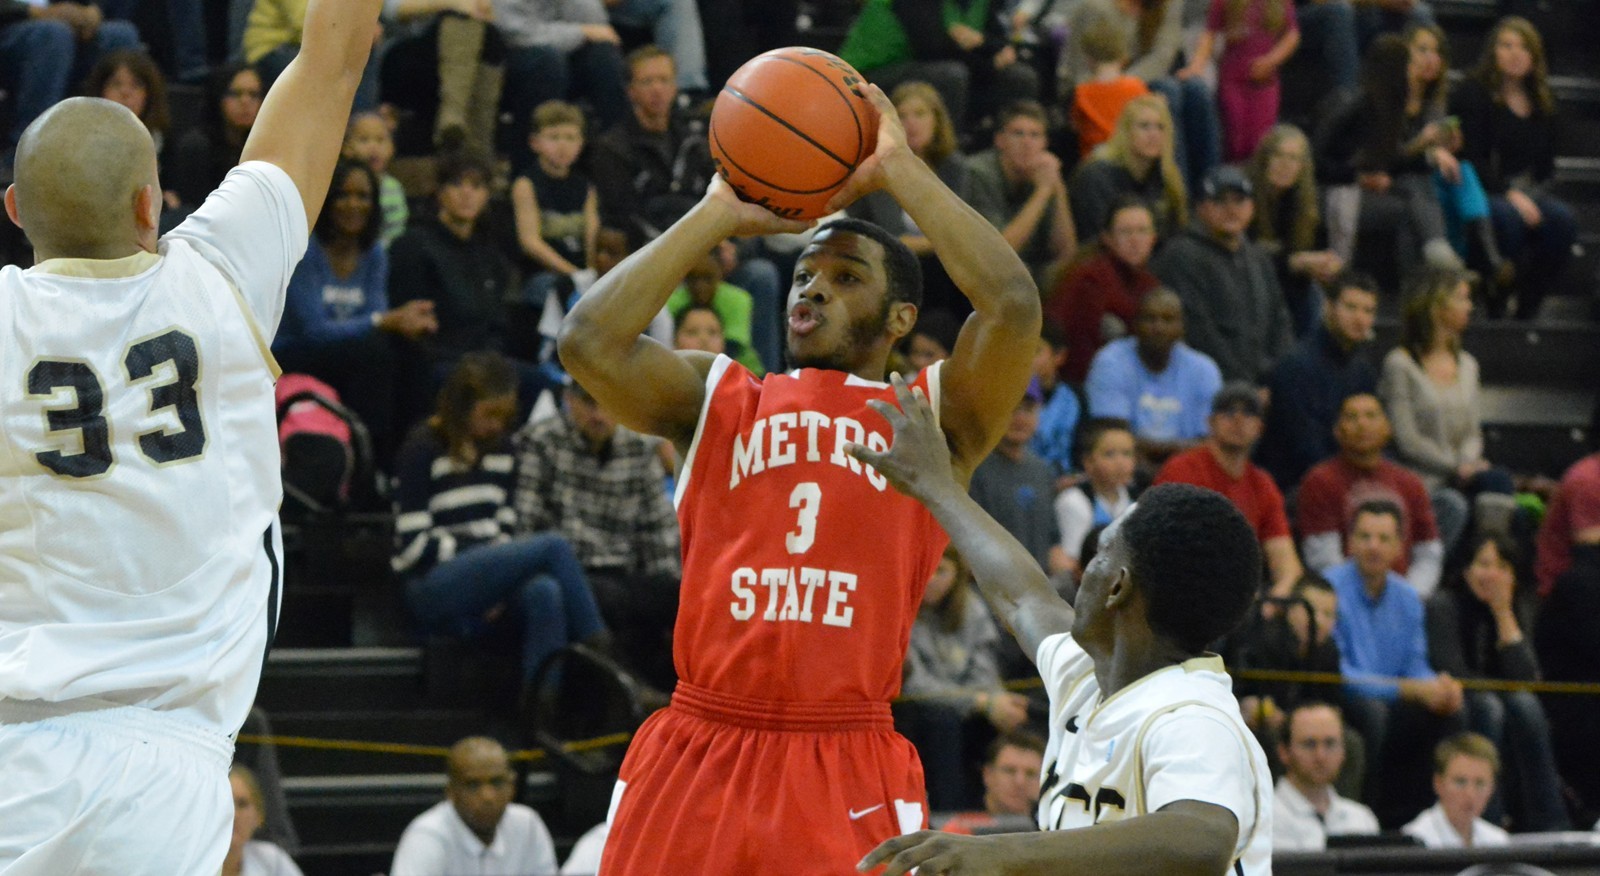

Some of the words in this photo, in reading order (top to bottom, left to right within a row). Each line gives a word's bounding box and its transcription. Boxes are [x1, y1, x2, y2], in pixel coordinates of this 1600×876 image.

[23, 325, 211, 482] 33
[785, 482, 822, 554] 3
[730, 566, 857, 628] STATE
